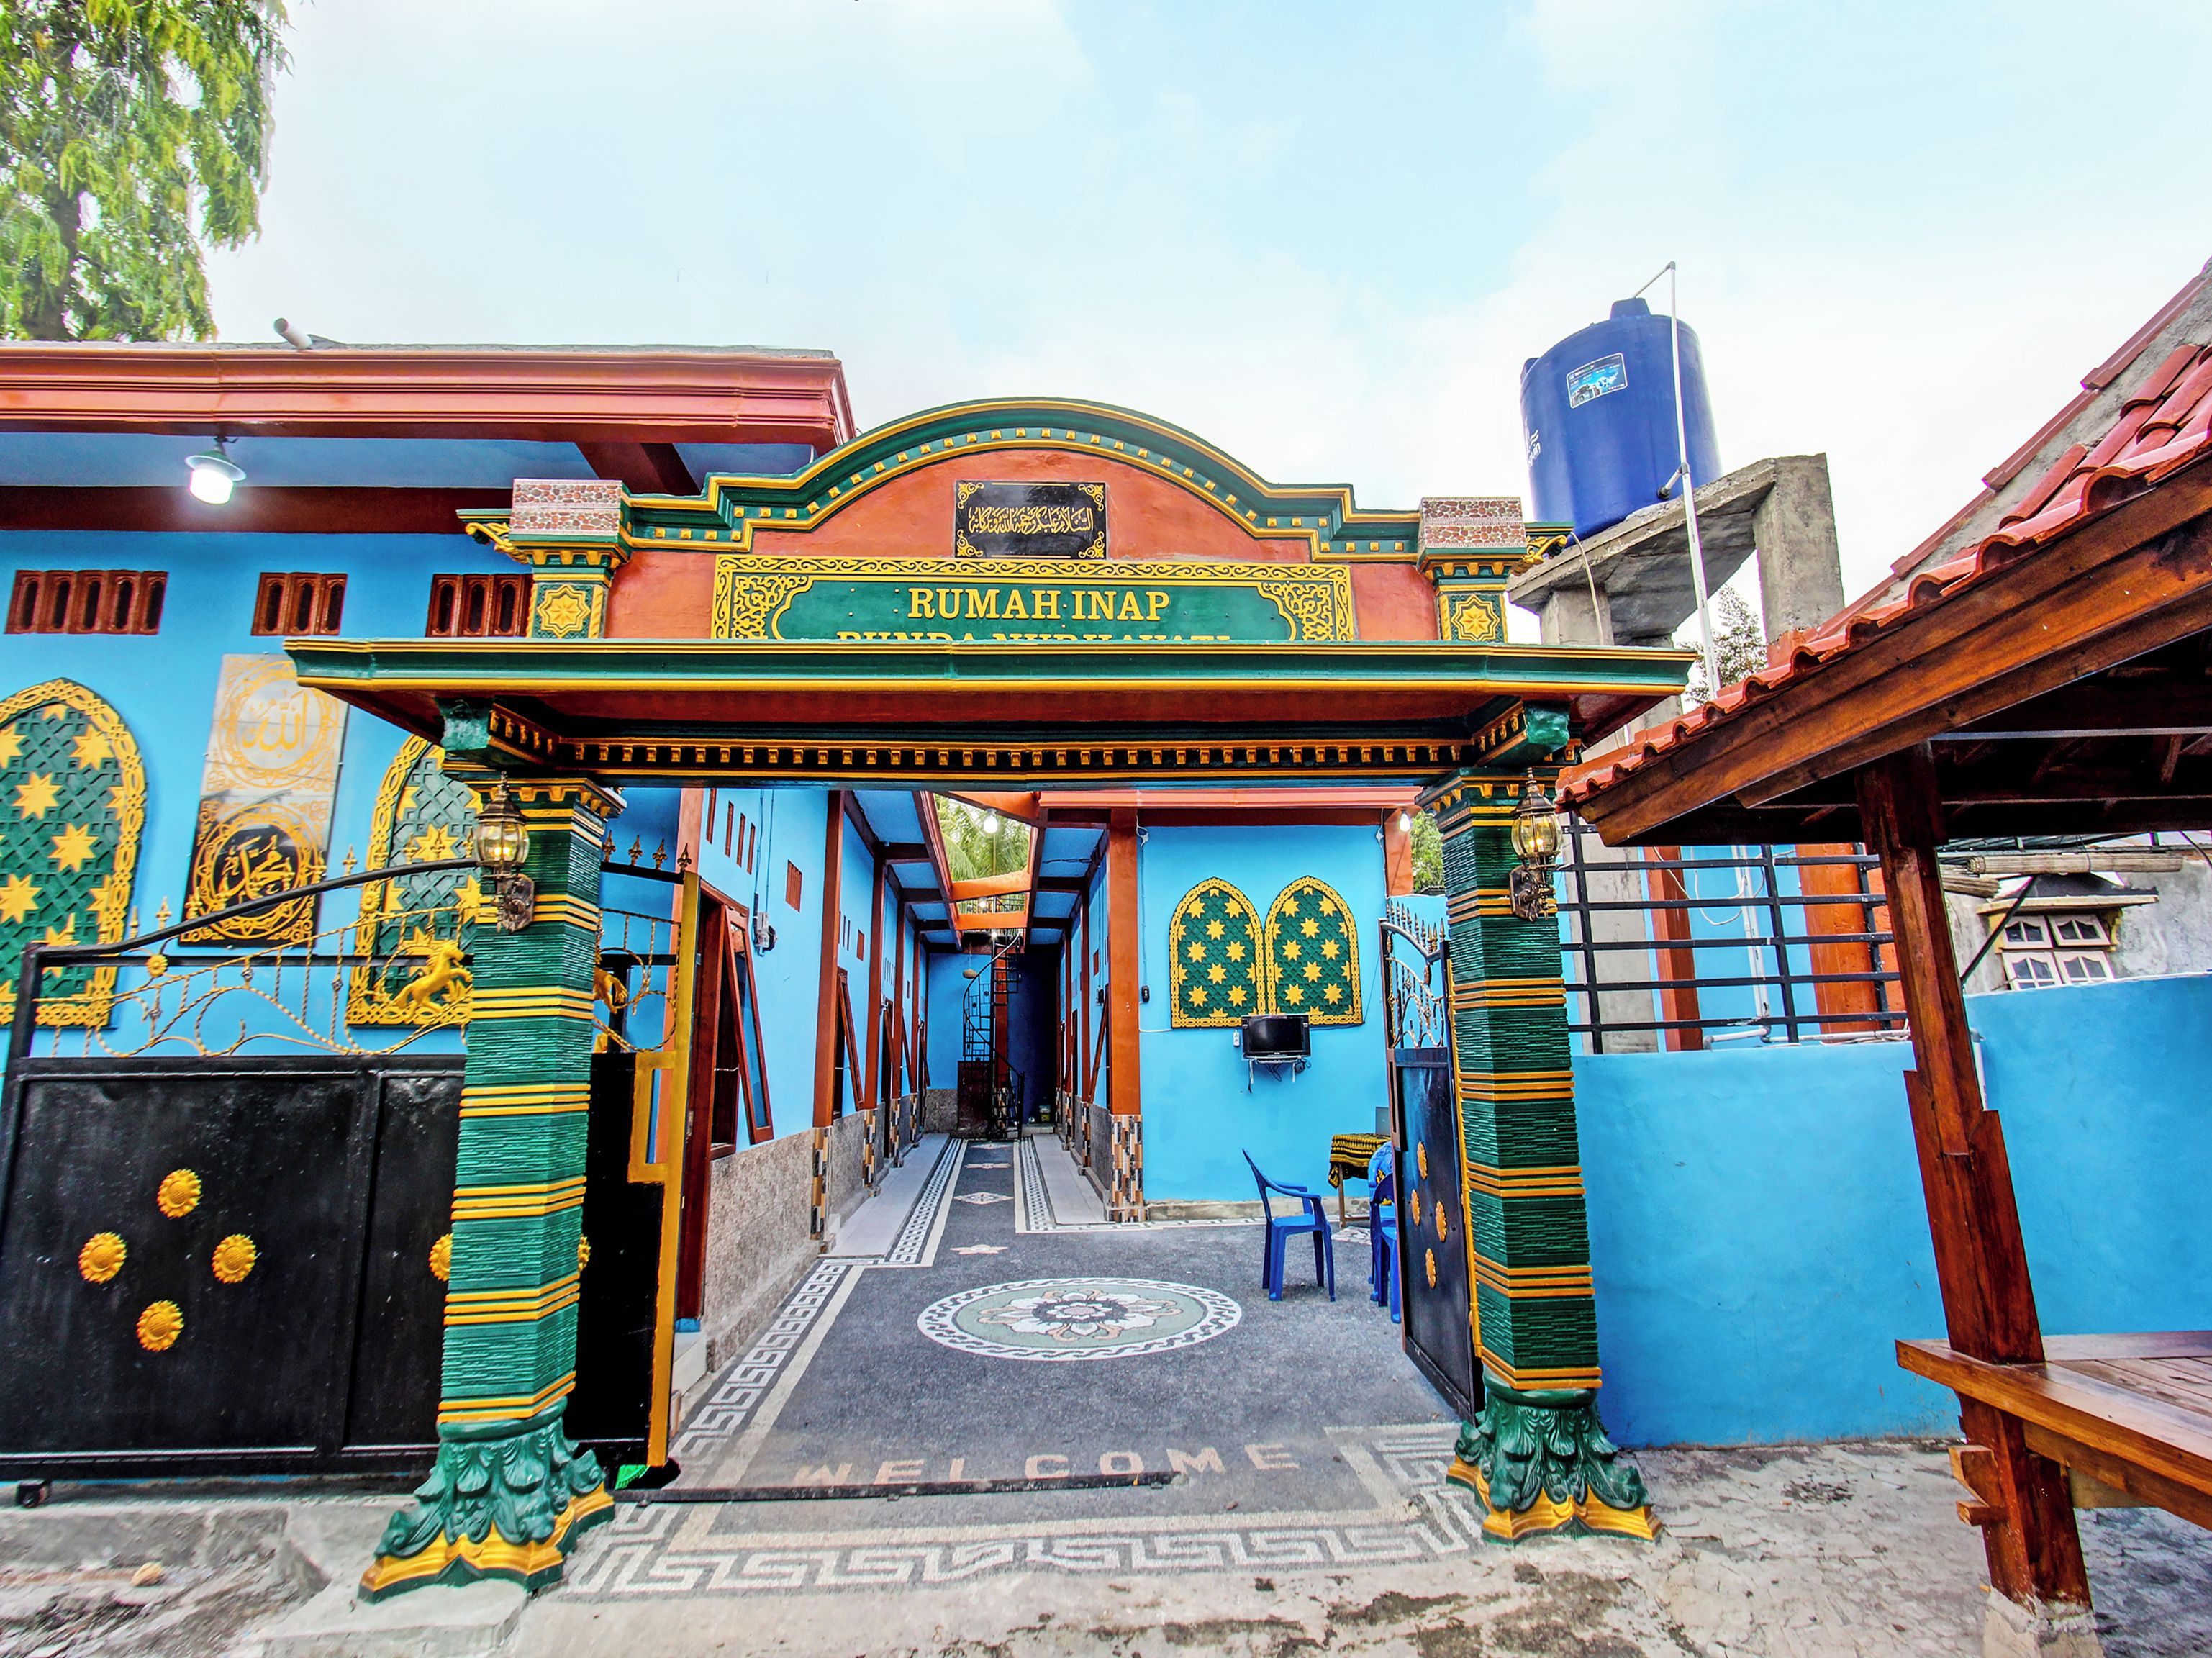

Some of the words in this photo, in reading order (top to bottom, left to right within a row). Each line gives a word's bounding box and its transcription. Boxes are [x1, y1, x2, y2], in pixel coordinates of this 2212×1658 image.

[907, 587, 1062, 620] RUMAH
[1071, 589, 1170, 621] INAP
[792, 1442, 1300, 1487] WELCOME
